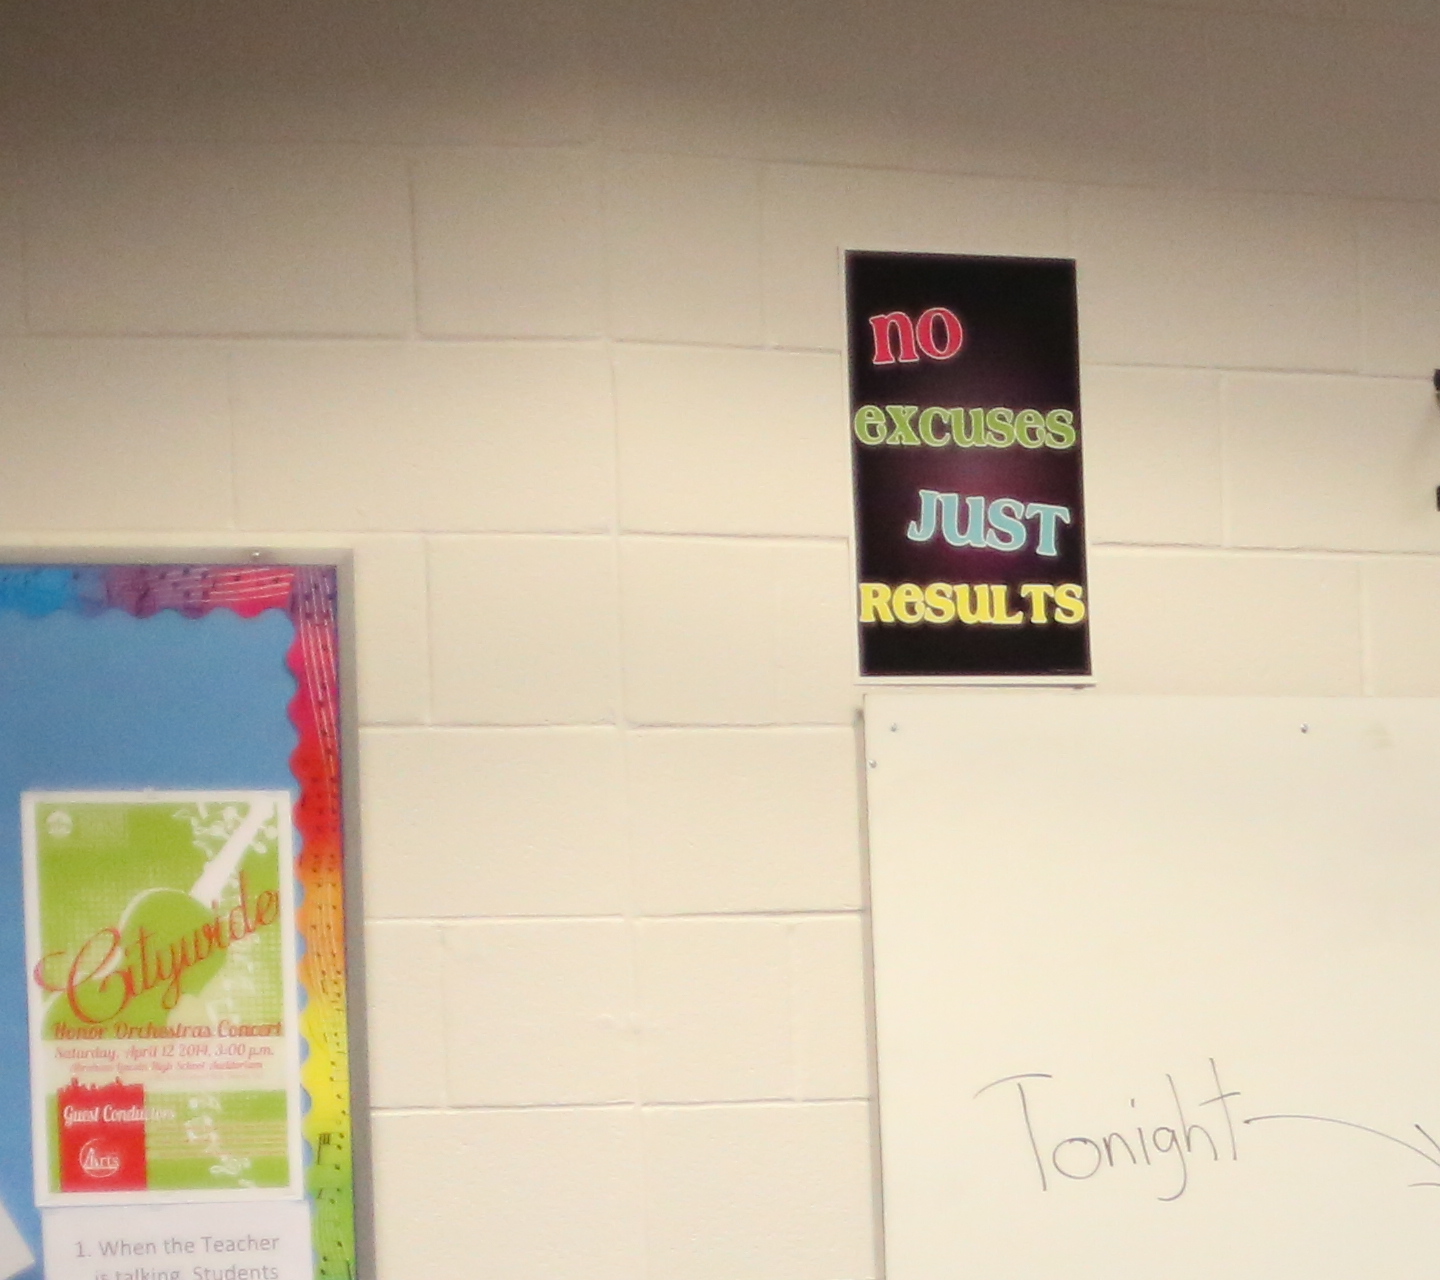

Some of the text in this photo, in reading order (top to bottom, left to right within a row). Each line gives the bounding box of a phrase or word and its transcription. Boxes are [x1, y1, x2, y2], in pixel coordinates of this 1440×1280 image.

[854, 405, 1077, 449] excuses
[907, 489, 1070, 556] JUST
[33, 871, 279, 1024] Citywide
[55, 1019, 283, 1039] Honor Orchestras Concert
[126, 1046, 157, 1058] April
[162, 1045, 174, 1057] 12
[63, 1105, 99, 1128] Guest
[974, 1058, 1241, 1201] Tonight
[99, 1239, 156, 1257] When
[163, 1238, 195, 1255] the
[201, 1235, 280, 1253] Teacher
